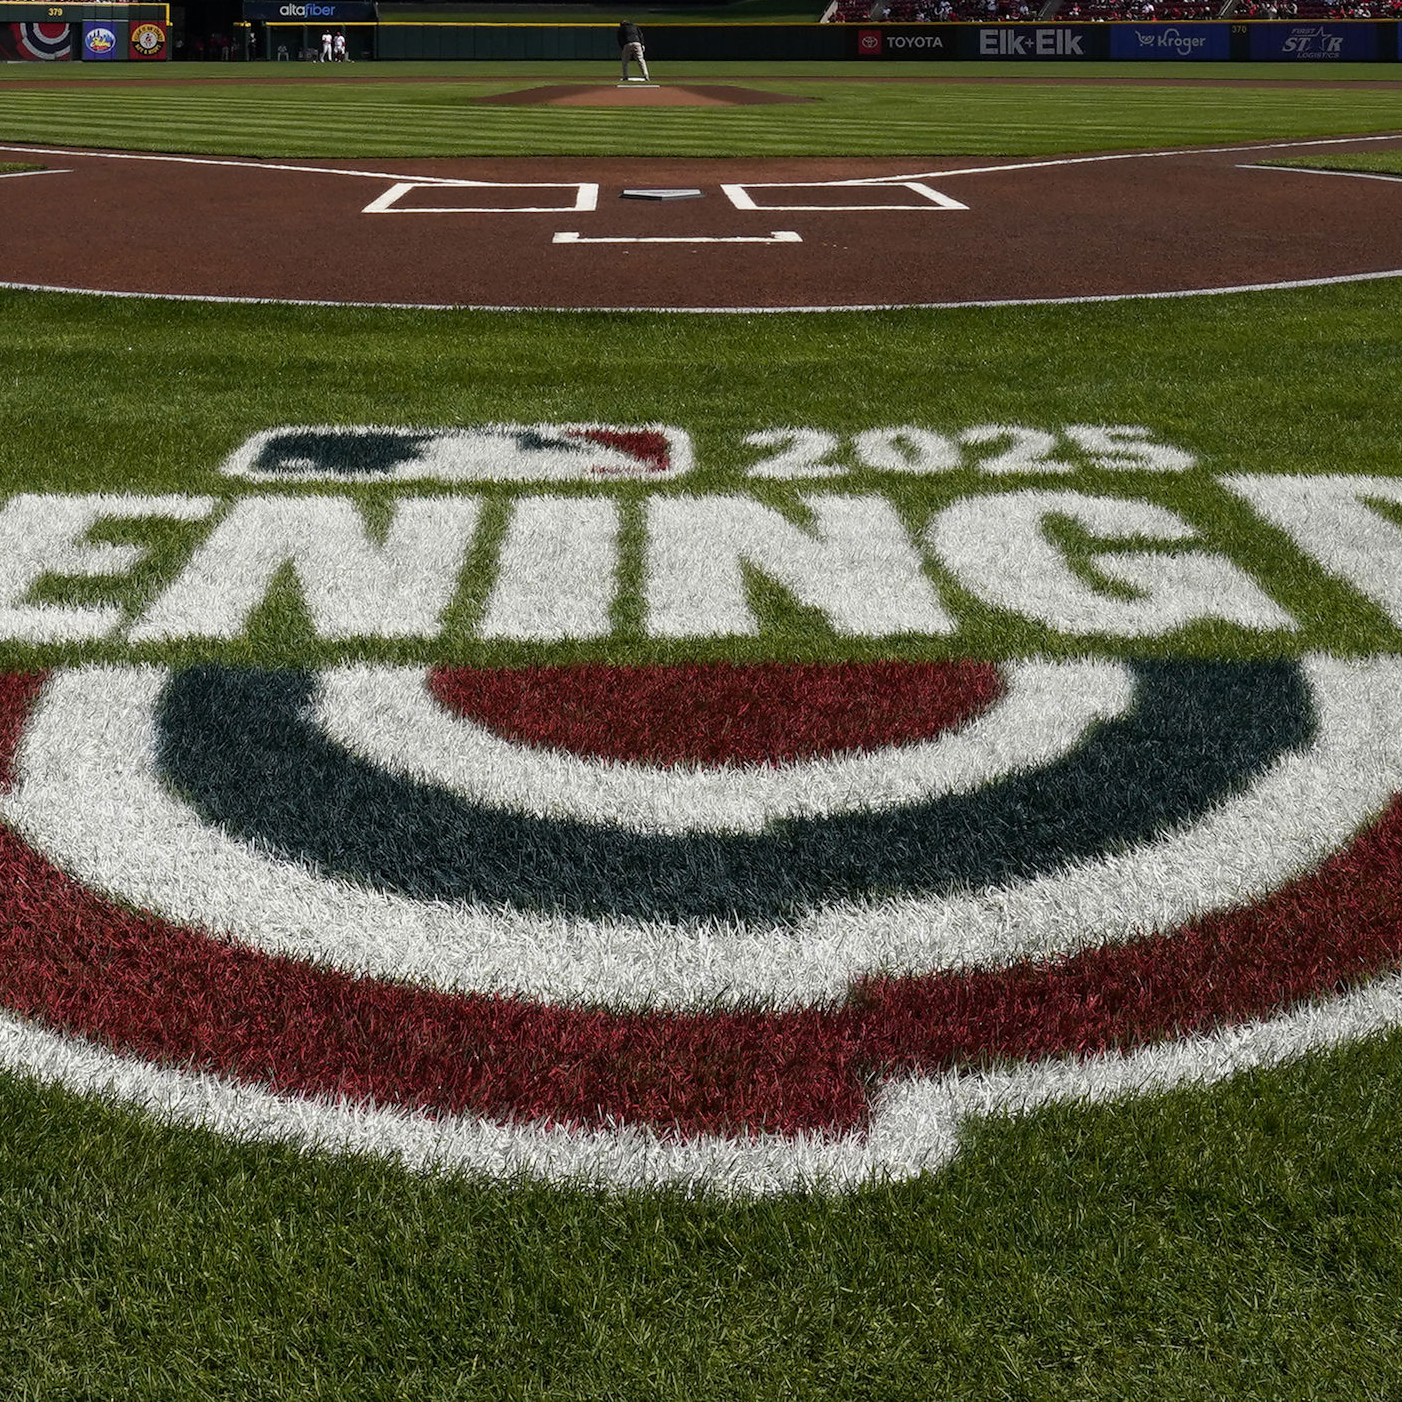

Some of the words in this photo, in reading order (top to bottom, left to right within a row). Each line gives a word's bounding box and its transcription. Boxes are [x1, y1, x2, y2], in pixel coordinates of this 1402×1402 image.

[48, 8, 63, 16] 379
[280, 3, 335, 18] altafiber
[886, 36, 943, 48] TOYOTA
[980, 29, 1084, 55] Elk+Elk
[1158, 29, 1206, 55] Kroger
[743, 424, 1198, 480] 2025
